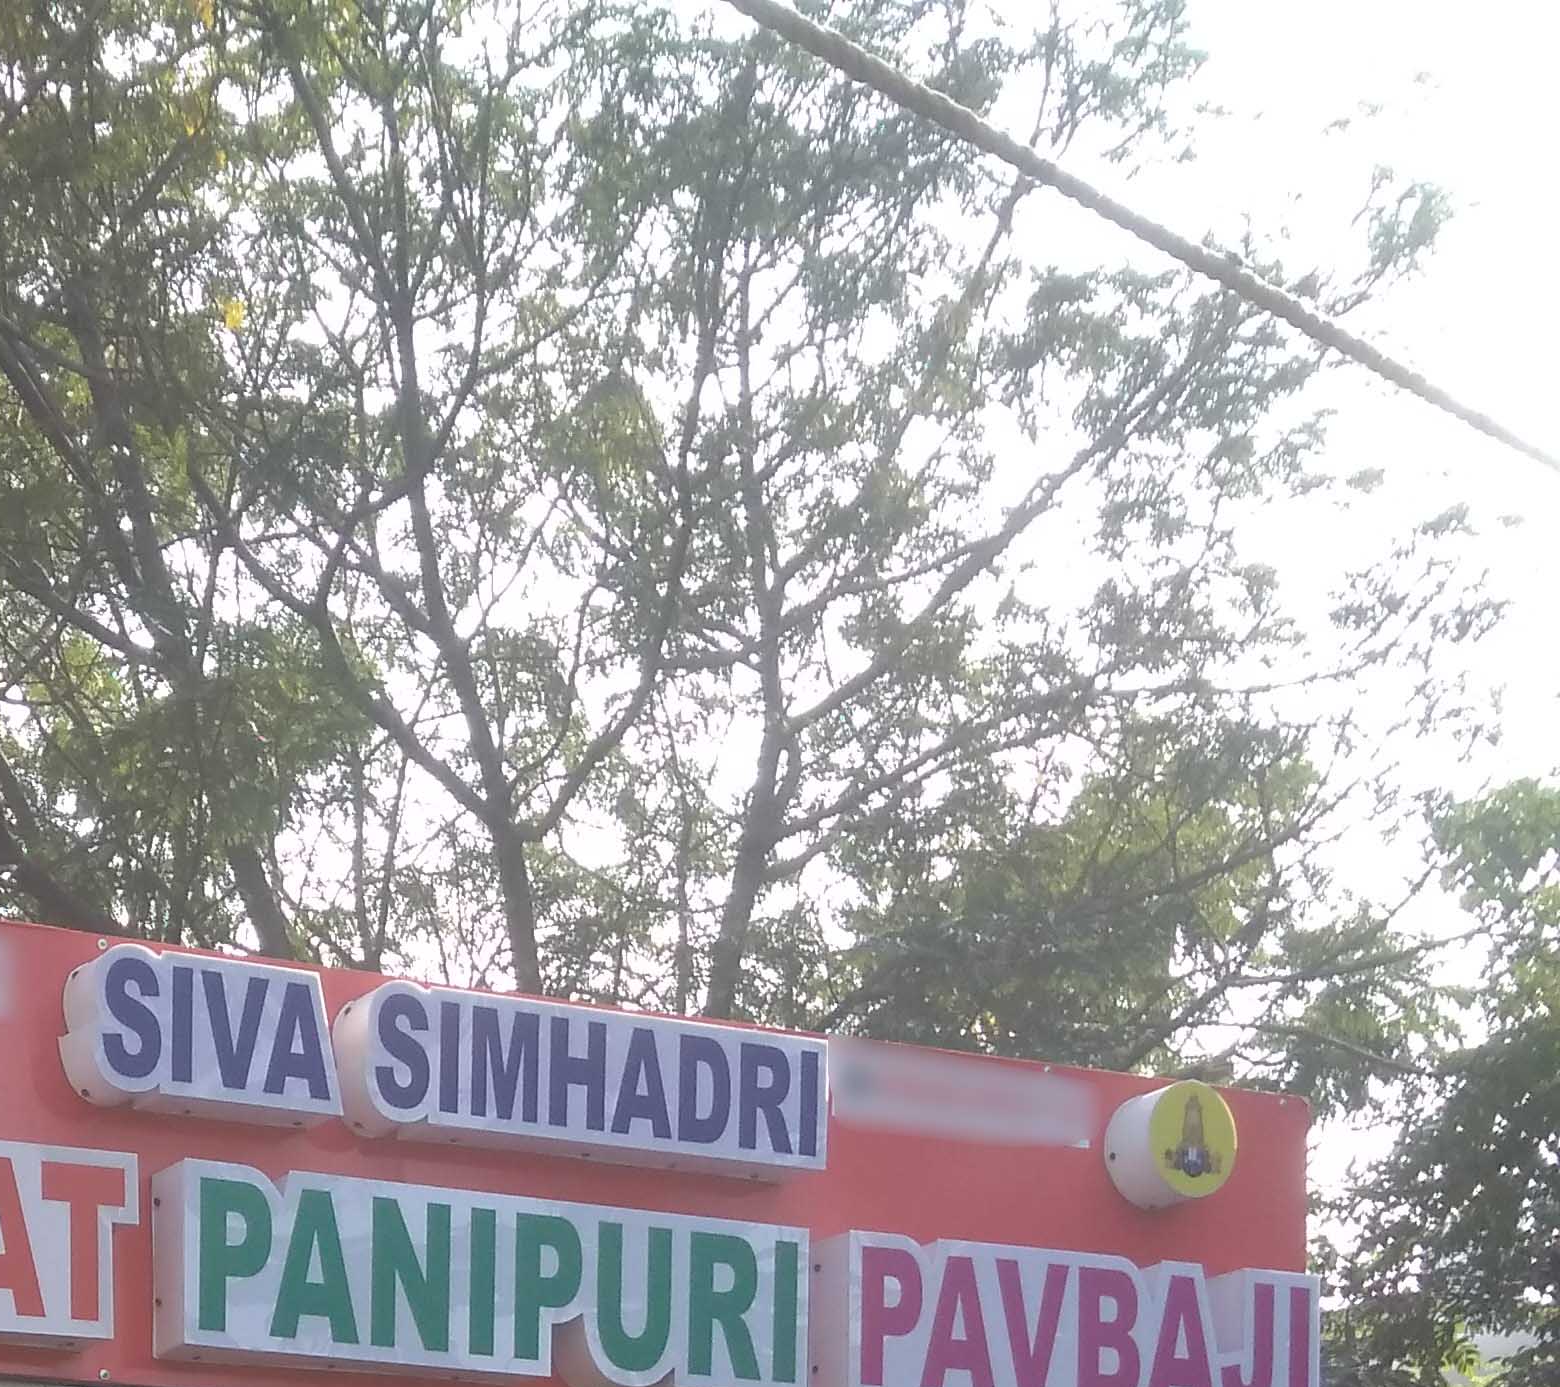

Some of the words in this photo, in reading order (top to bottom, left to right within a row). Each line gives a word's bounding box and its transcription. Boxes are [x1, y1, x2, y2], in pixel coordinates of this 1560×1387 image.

[102, 955, 334, 1114] SIVA
[376, 980, 823, 1161] SIMHADRI
[196, 1175, 807, 1387] PANIPURI
